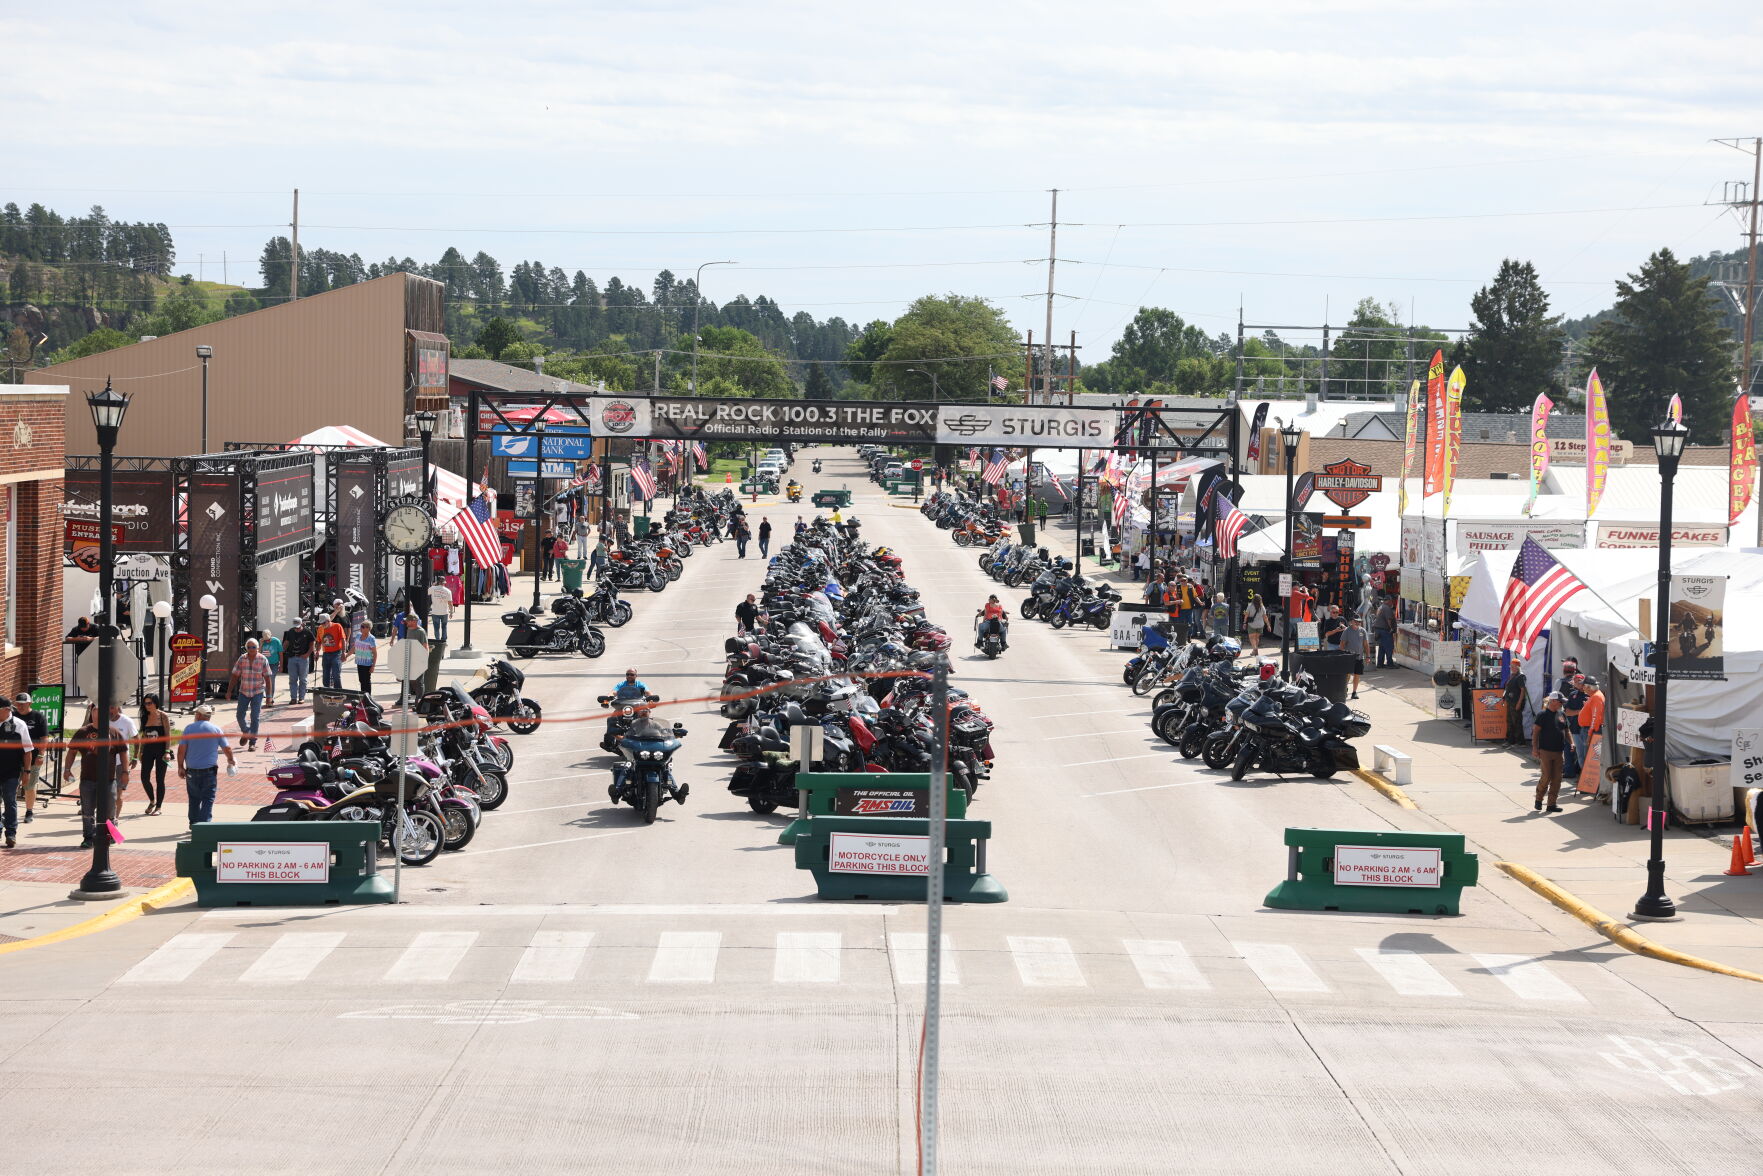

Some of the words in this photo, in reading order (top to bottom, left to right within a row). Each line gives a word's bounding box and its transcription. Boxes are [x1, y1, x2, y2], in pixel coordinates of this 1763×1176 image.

[654, 403, 710, 420] REAL
[716, 404, 776, 421] ROCK
[782, 406, 837, 423] 100.3
[843, 407, 884, 424] THE
[891, 409, 934, 425] FOX
[704, 423, 745, 434] Official
[747, 425, 780, 435] Radio
[782, 426, 822, 436] Station
[825, 427, 837, 436] of
[840, 427, 858, 436] the
[860, 427, 887, 438] Rally
[1002, 418, 1102, 437] STURGIS
[541, 437, 585, 447] NATIONAL
[1554, 441, 1566, 450] 12
[1568, 442, 1587, 452] Step
[541, 446, 564, 455] BANK
[541, 462, 564, 473] ATM
[1332, 465, 1365, 475] MOTOR
[1733, 422, 1747, 513] BURGER
[1317, 477, 1378, 489] HARLEY-DAVIDSON
[389, 496, 430, 509] STURGIS
[72, 523, 118, 534] MUSEM
[72, 531, 118, 541] ENTRAE
[1465, 531, 1515, 541] SAUSAGE
[1607, 530, 1661, 541] FUNNE
[1670, 531, 1720, 542] CAKES
[1469, 542, 1509, 551] PHILLY
[116, 567, 150, 577] Junction
[155, 567, 169, 578] Ave
[851, 798, 916, 815] AMSOIL
[838, 851, 901, 862] MOTORCYCLE
[902, 854, 927, 862] ONLY
[834, 861, 874, 870] PARKING
[876, 863, 897, 871] THIS
[898, 864, 930, 872] BLOCK
[1339, 864, 1351, 872] NO
[1353, 865, 1390, 873] PARKING
[246, 871, 266, 879] THIS
[268, 871, 300, 879] BLOCK
[1361, 874, 1381, 882] THIS
